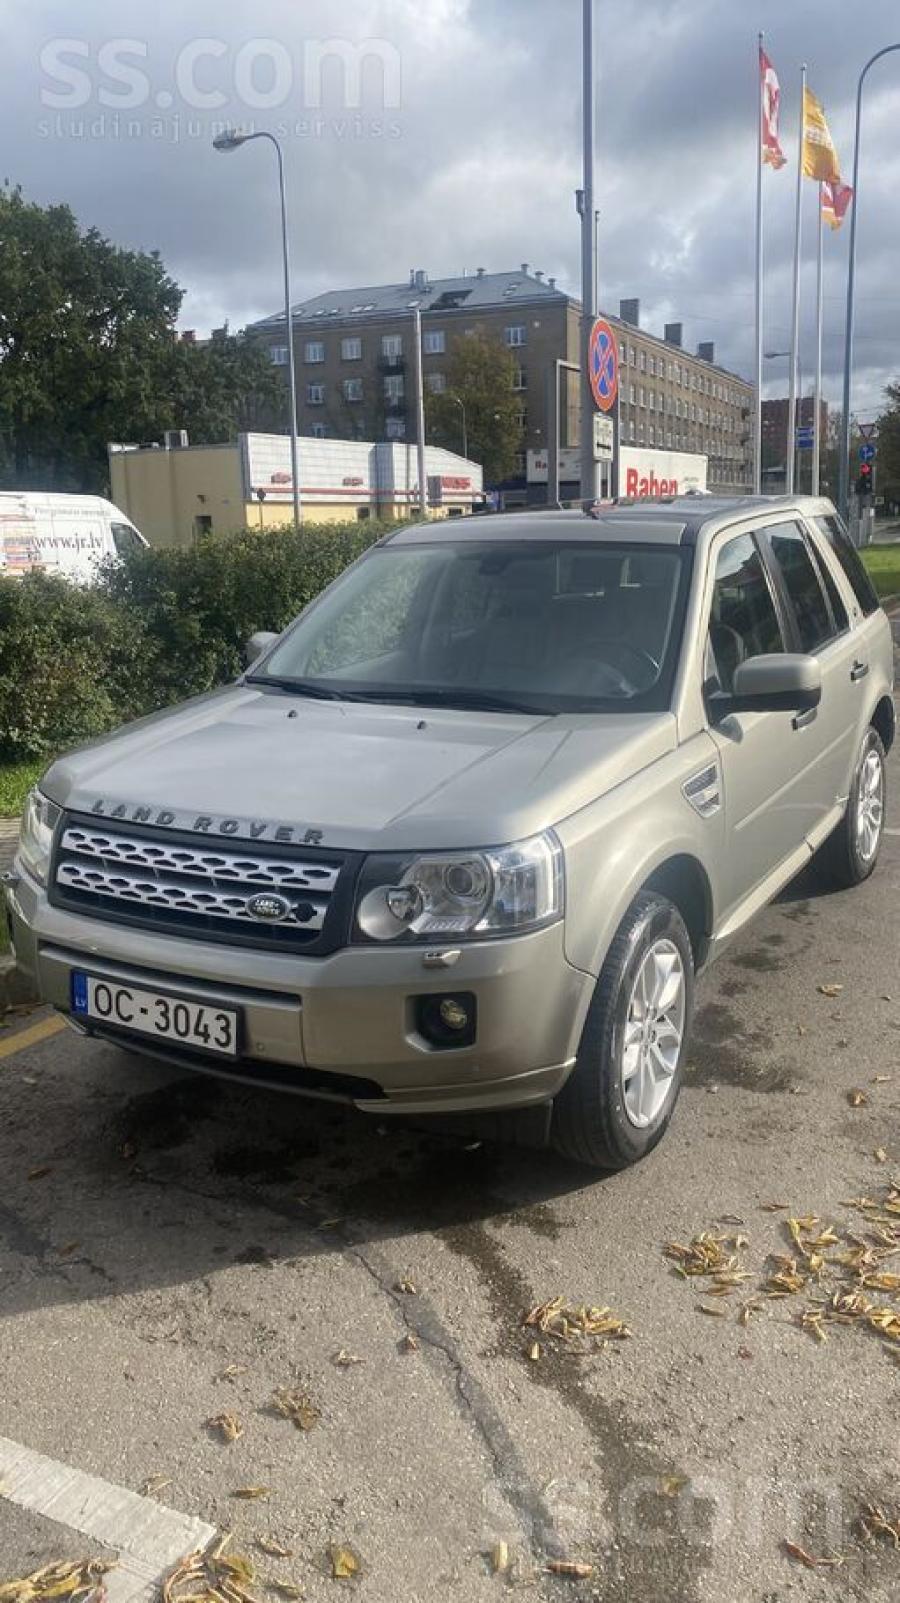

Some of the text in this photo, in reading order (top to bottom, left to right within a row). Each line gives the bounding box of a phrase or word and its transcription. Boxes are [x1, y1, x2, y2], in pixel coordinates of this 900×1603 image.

[91, 799, 325, 845] LAND ROVER
[94, 983, 232, 1049] OC-3043
